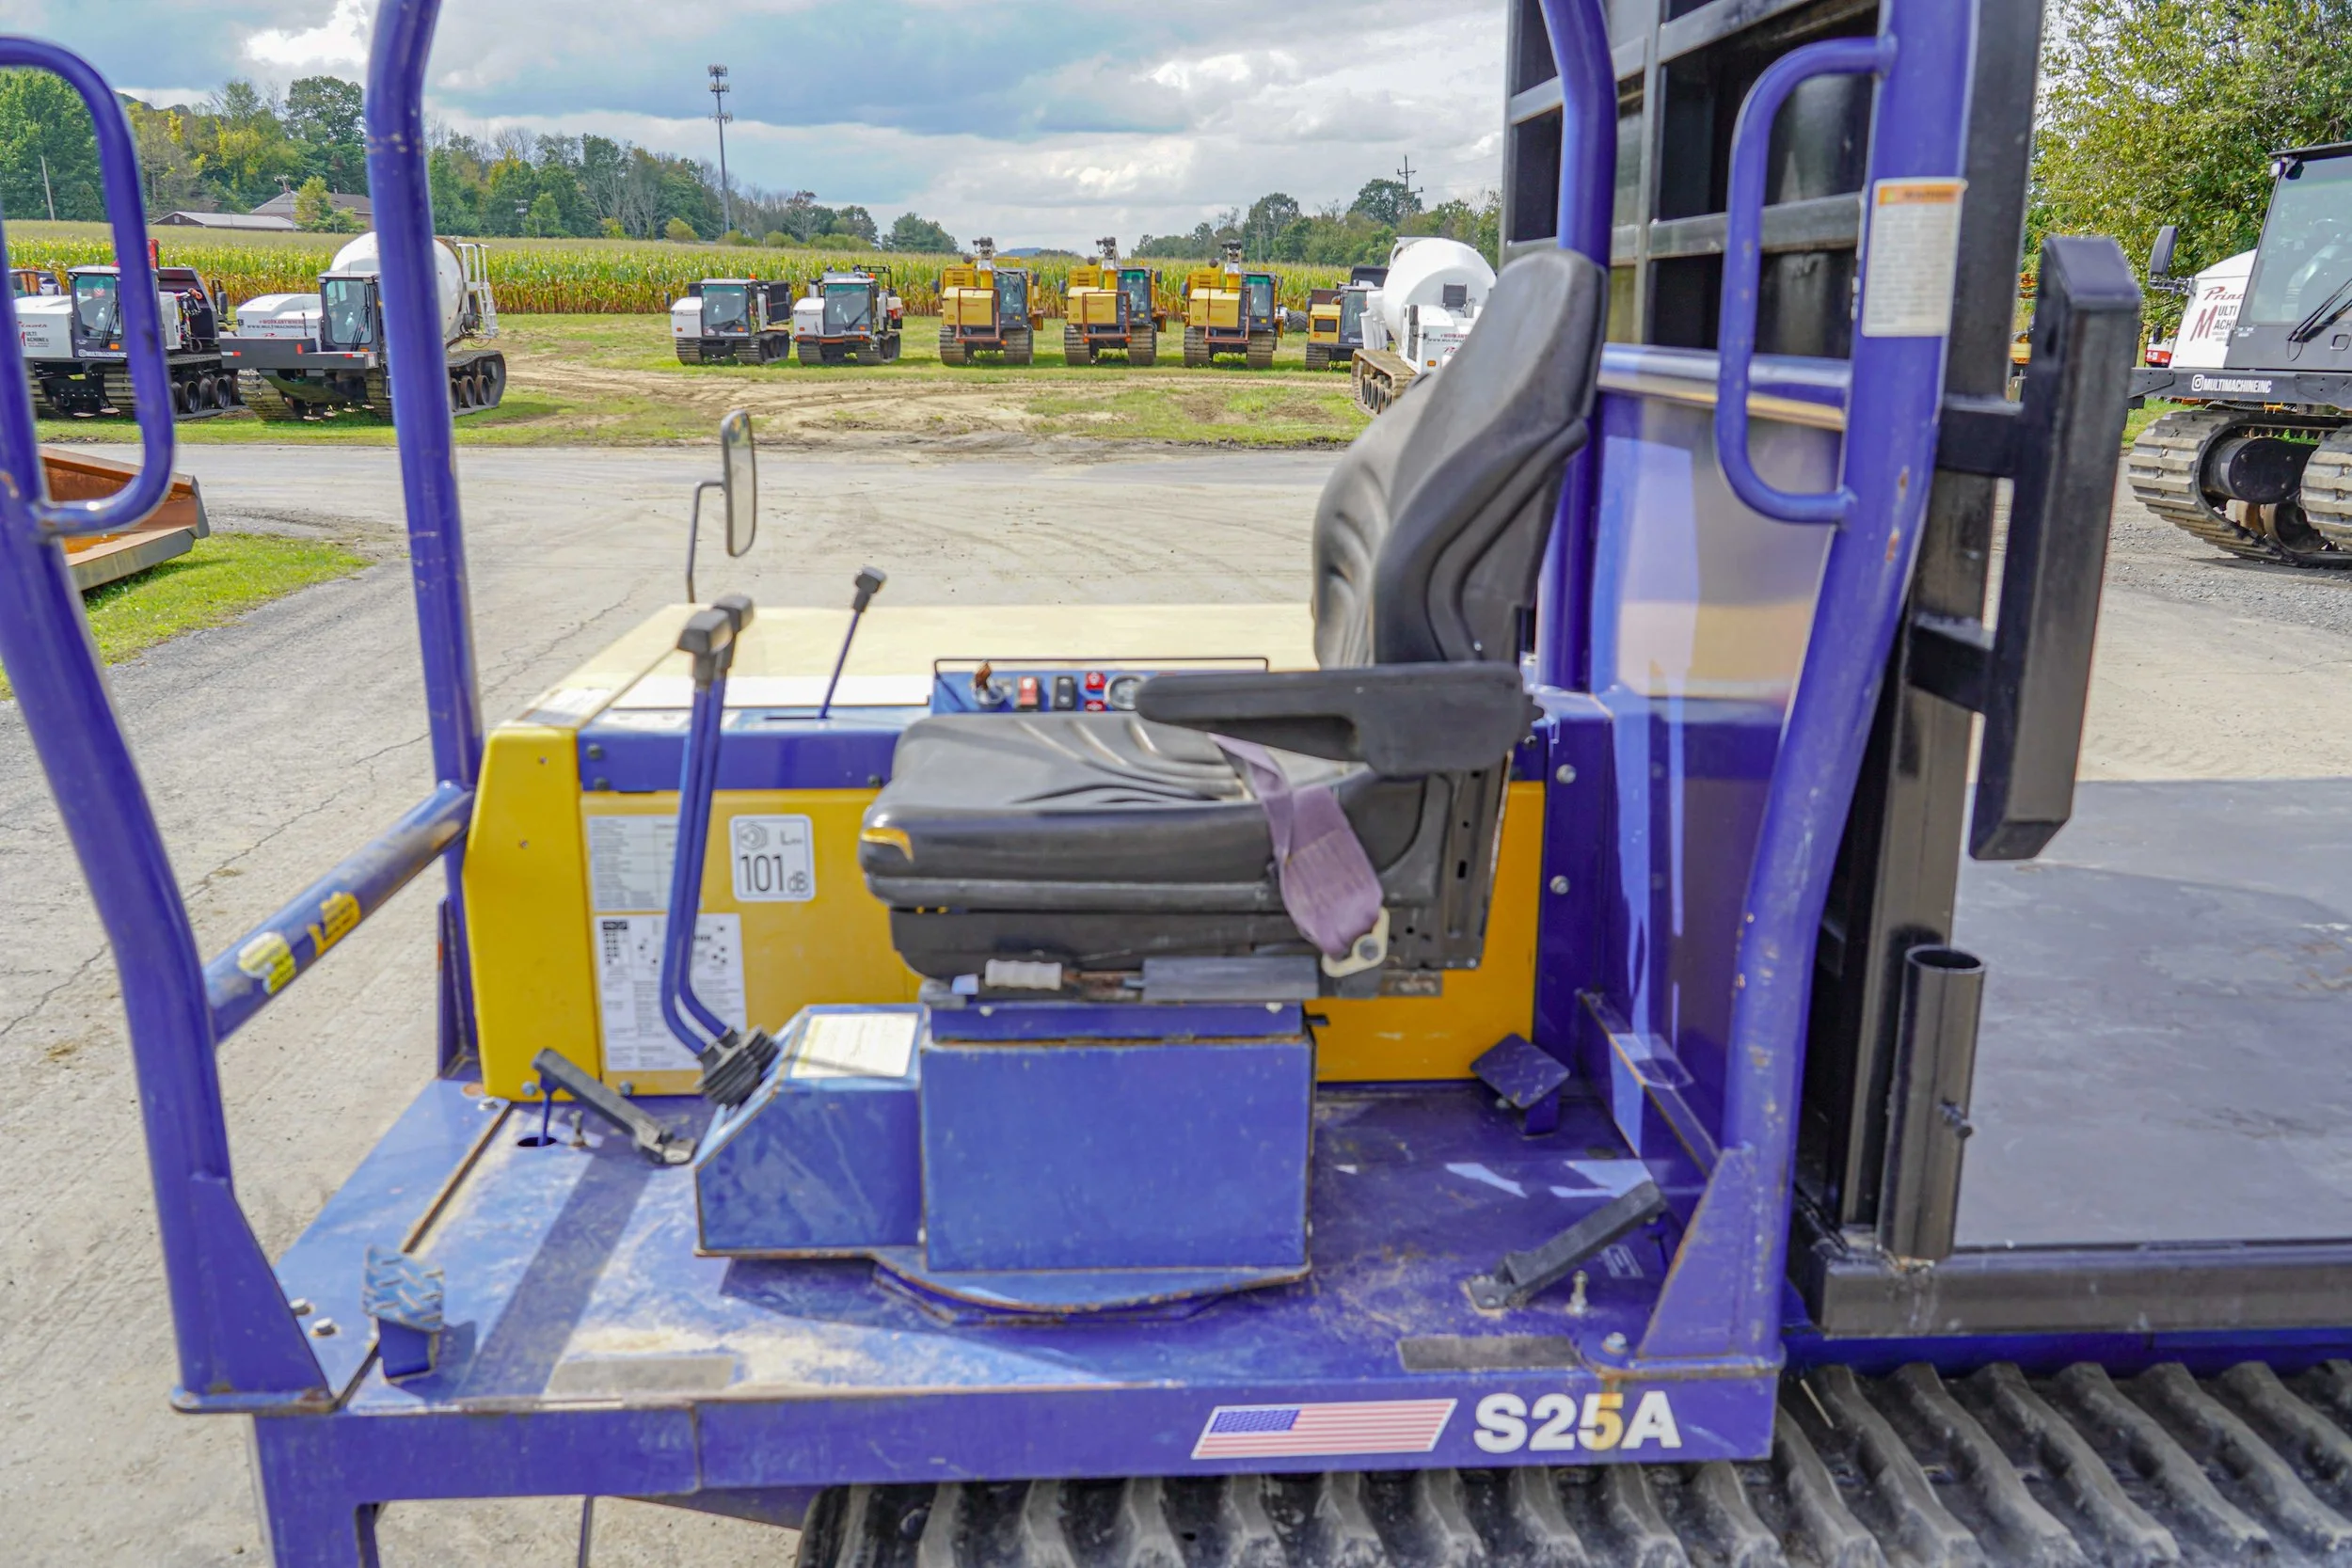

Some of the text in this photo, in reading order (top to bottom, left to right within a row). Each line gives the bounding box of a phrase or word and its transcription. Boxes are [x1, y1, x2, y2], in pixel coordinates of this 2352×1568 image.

[2202, 378, 2272, 393] MULTIMACHINEINC
[739, 852, 809, 894] 101 dB
[1473, 1390, 1683, 1453] S25A
